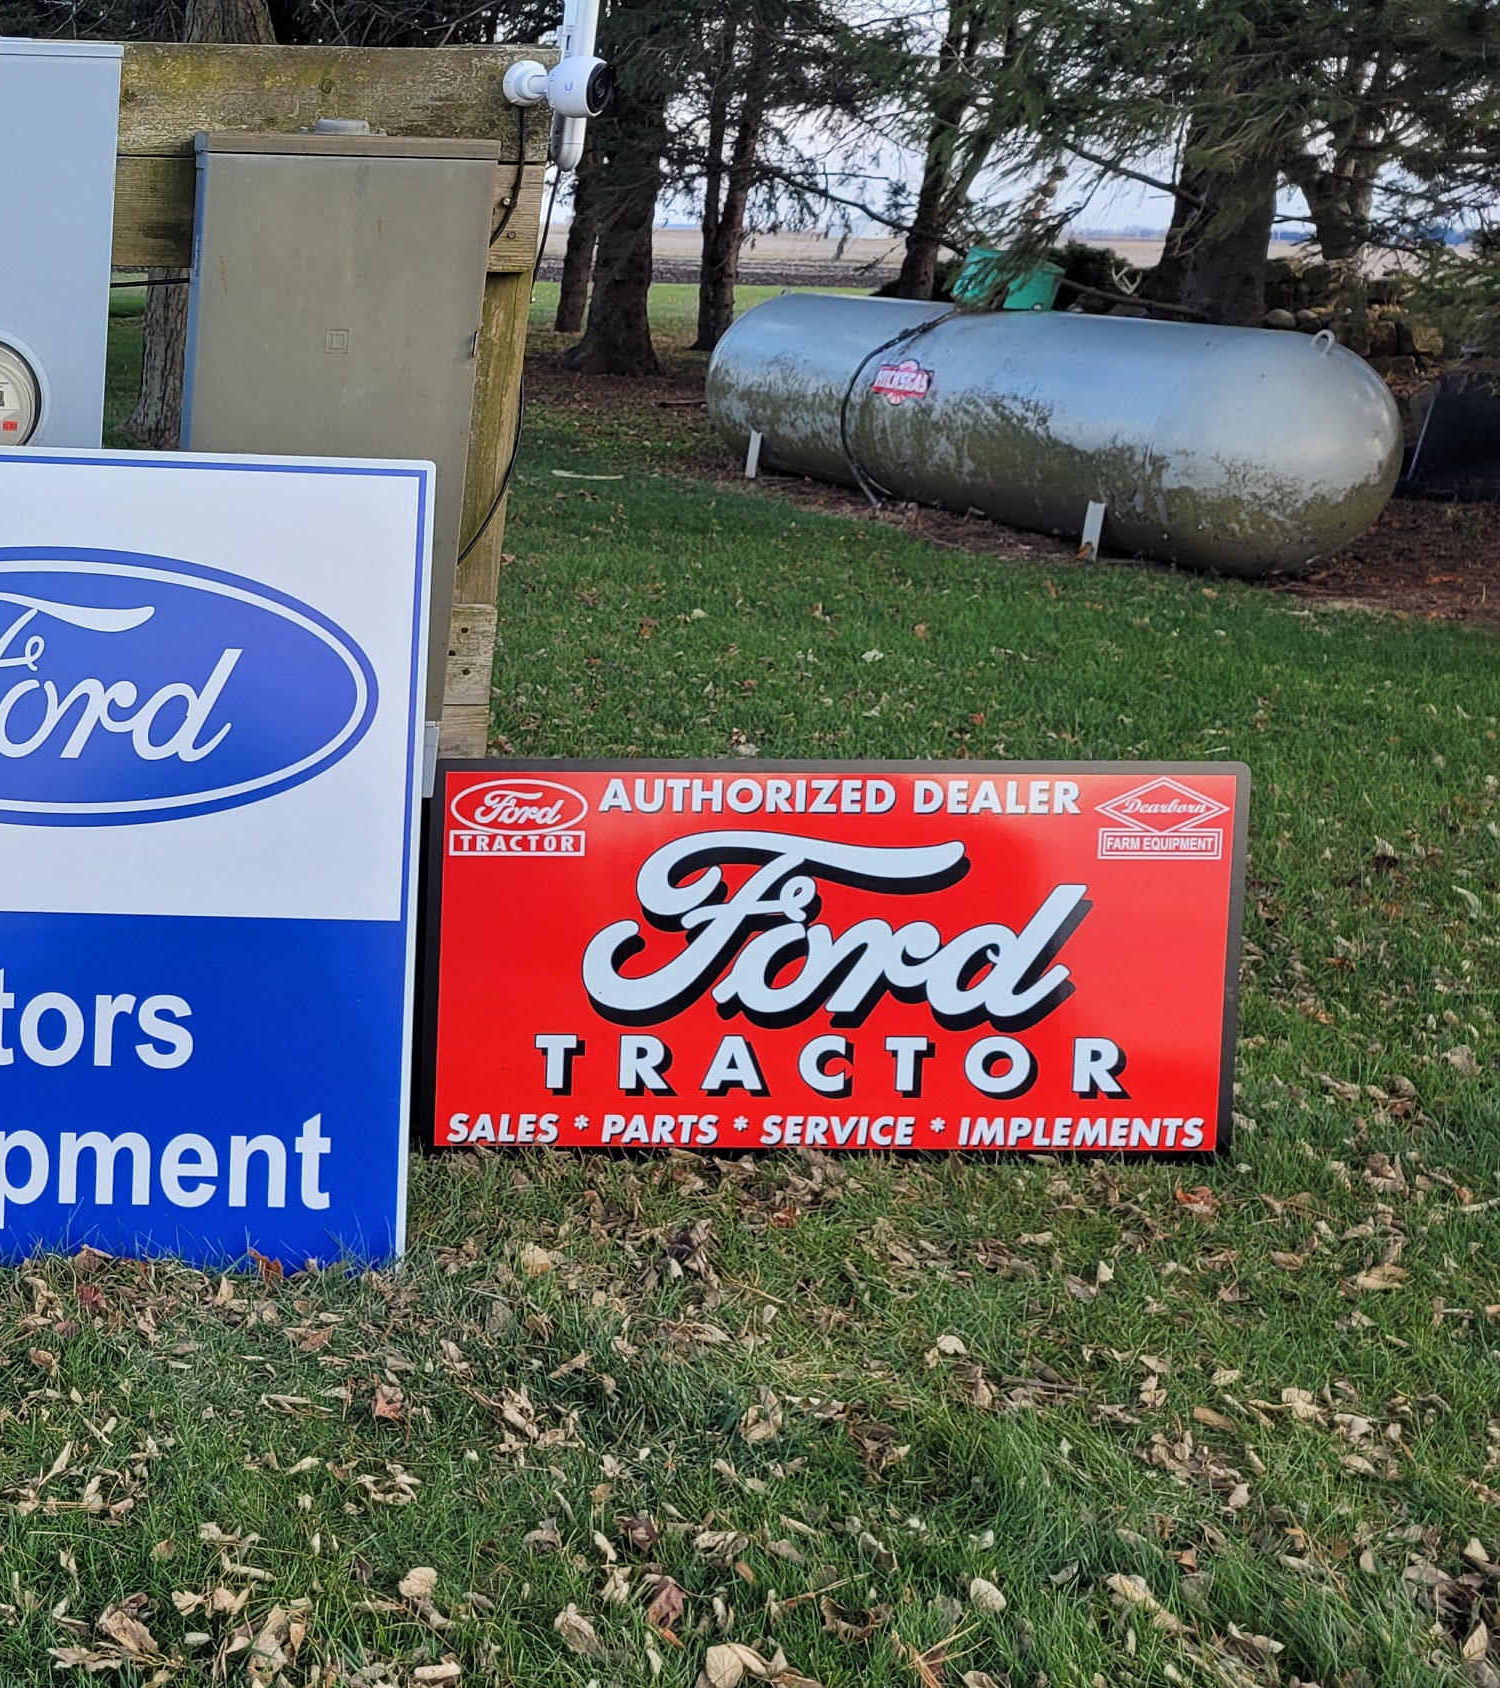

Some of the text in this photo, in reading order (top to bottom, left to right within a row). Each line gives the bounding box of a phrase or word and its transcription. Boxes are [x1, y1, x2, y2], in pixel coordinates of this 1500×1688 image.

[474, 789, 565, 825] Ford
[597, 776, 1082, 816] AUTHORIZED DEALER
[1122, 797, 1207, 815] Dearborn
[460, 835, 575, 852] TRACTOR
[1106, 836, 1214, 852] FARM EQUIPMENT
[581, 829, 1092, 1028] Ford
[535, 1034, 1127, 1099] TRACTOR
[446, 1113, 560, 1144] SALES
[601, 1114, 720, 1145] PARTS
[760, 1115, 915, 1147] SERVICE
[958, 1116, 1204, 1149] IMPLEMENTS
